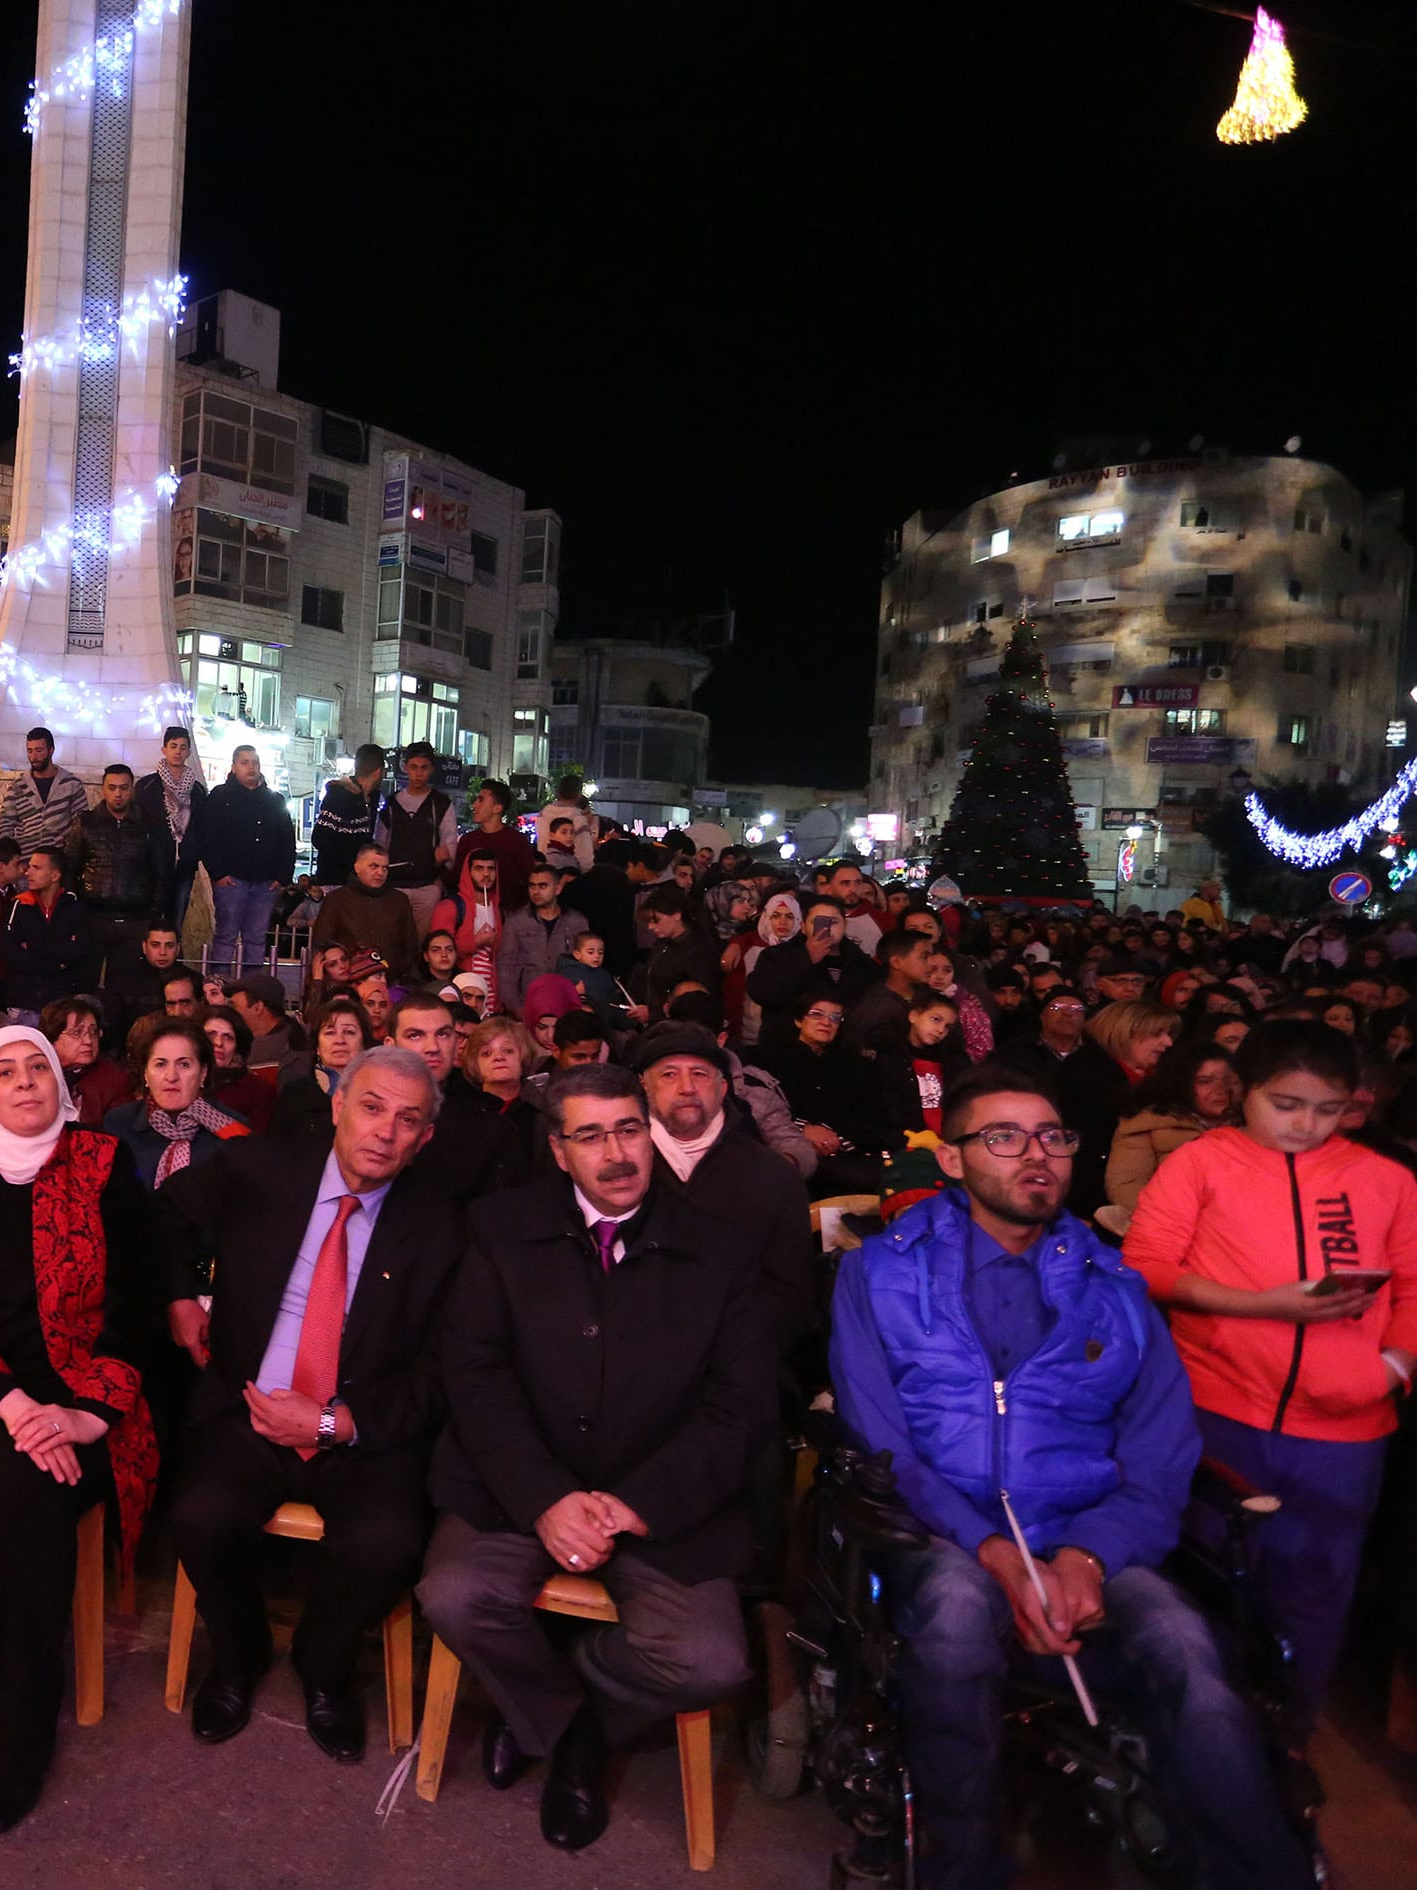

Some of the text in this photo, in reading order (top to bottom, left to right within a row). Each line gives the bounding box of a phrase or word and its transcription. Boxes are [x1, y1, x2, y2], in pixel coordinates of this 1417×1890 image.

[1048, 461, 1199, 489] RAYYAN BUILDING
[1316, 1191, 1360, 1273] TBALL
